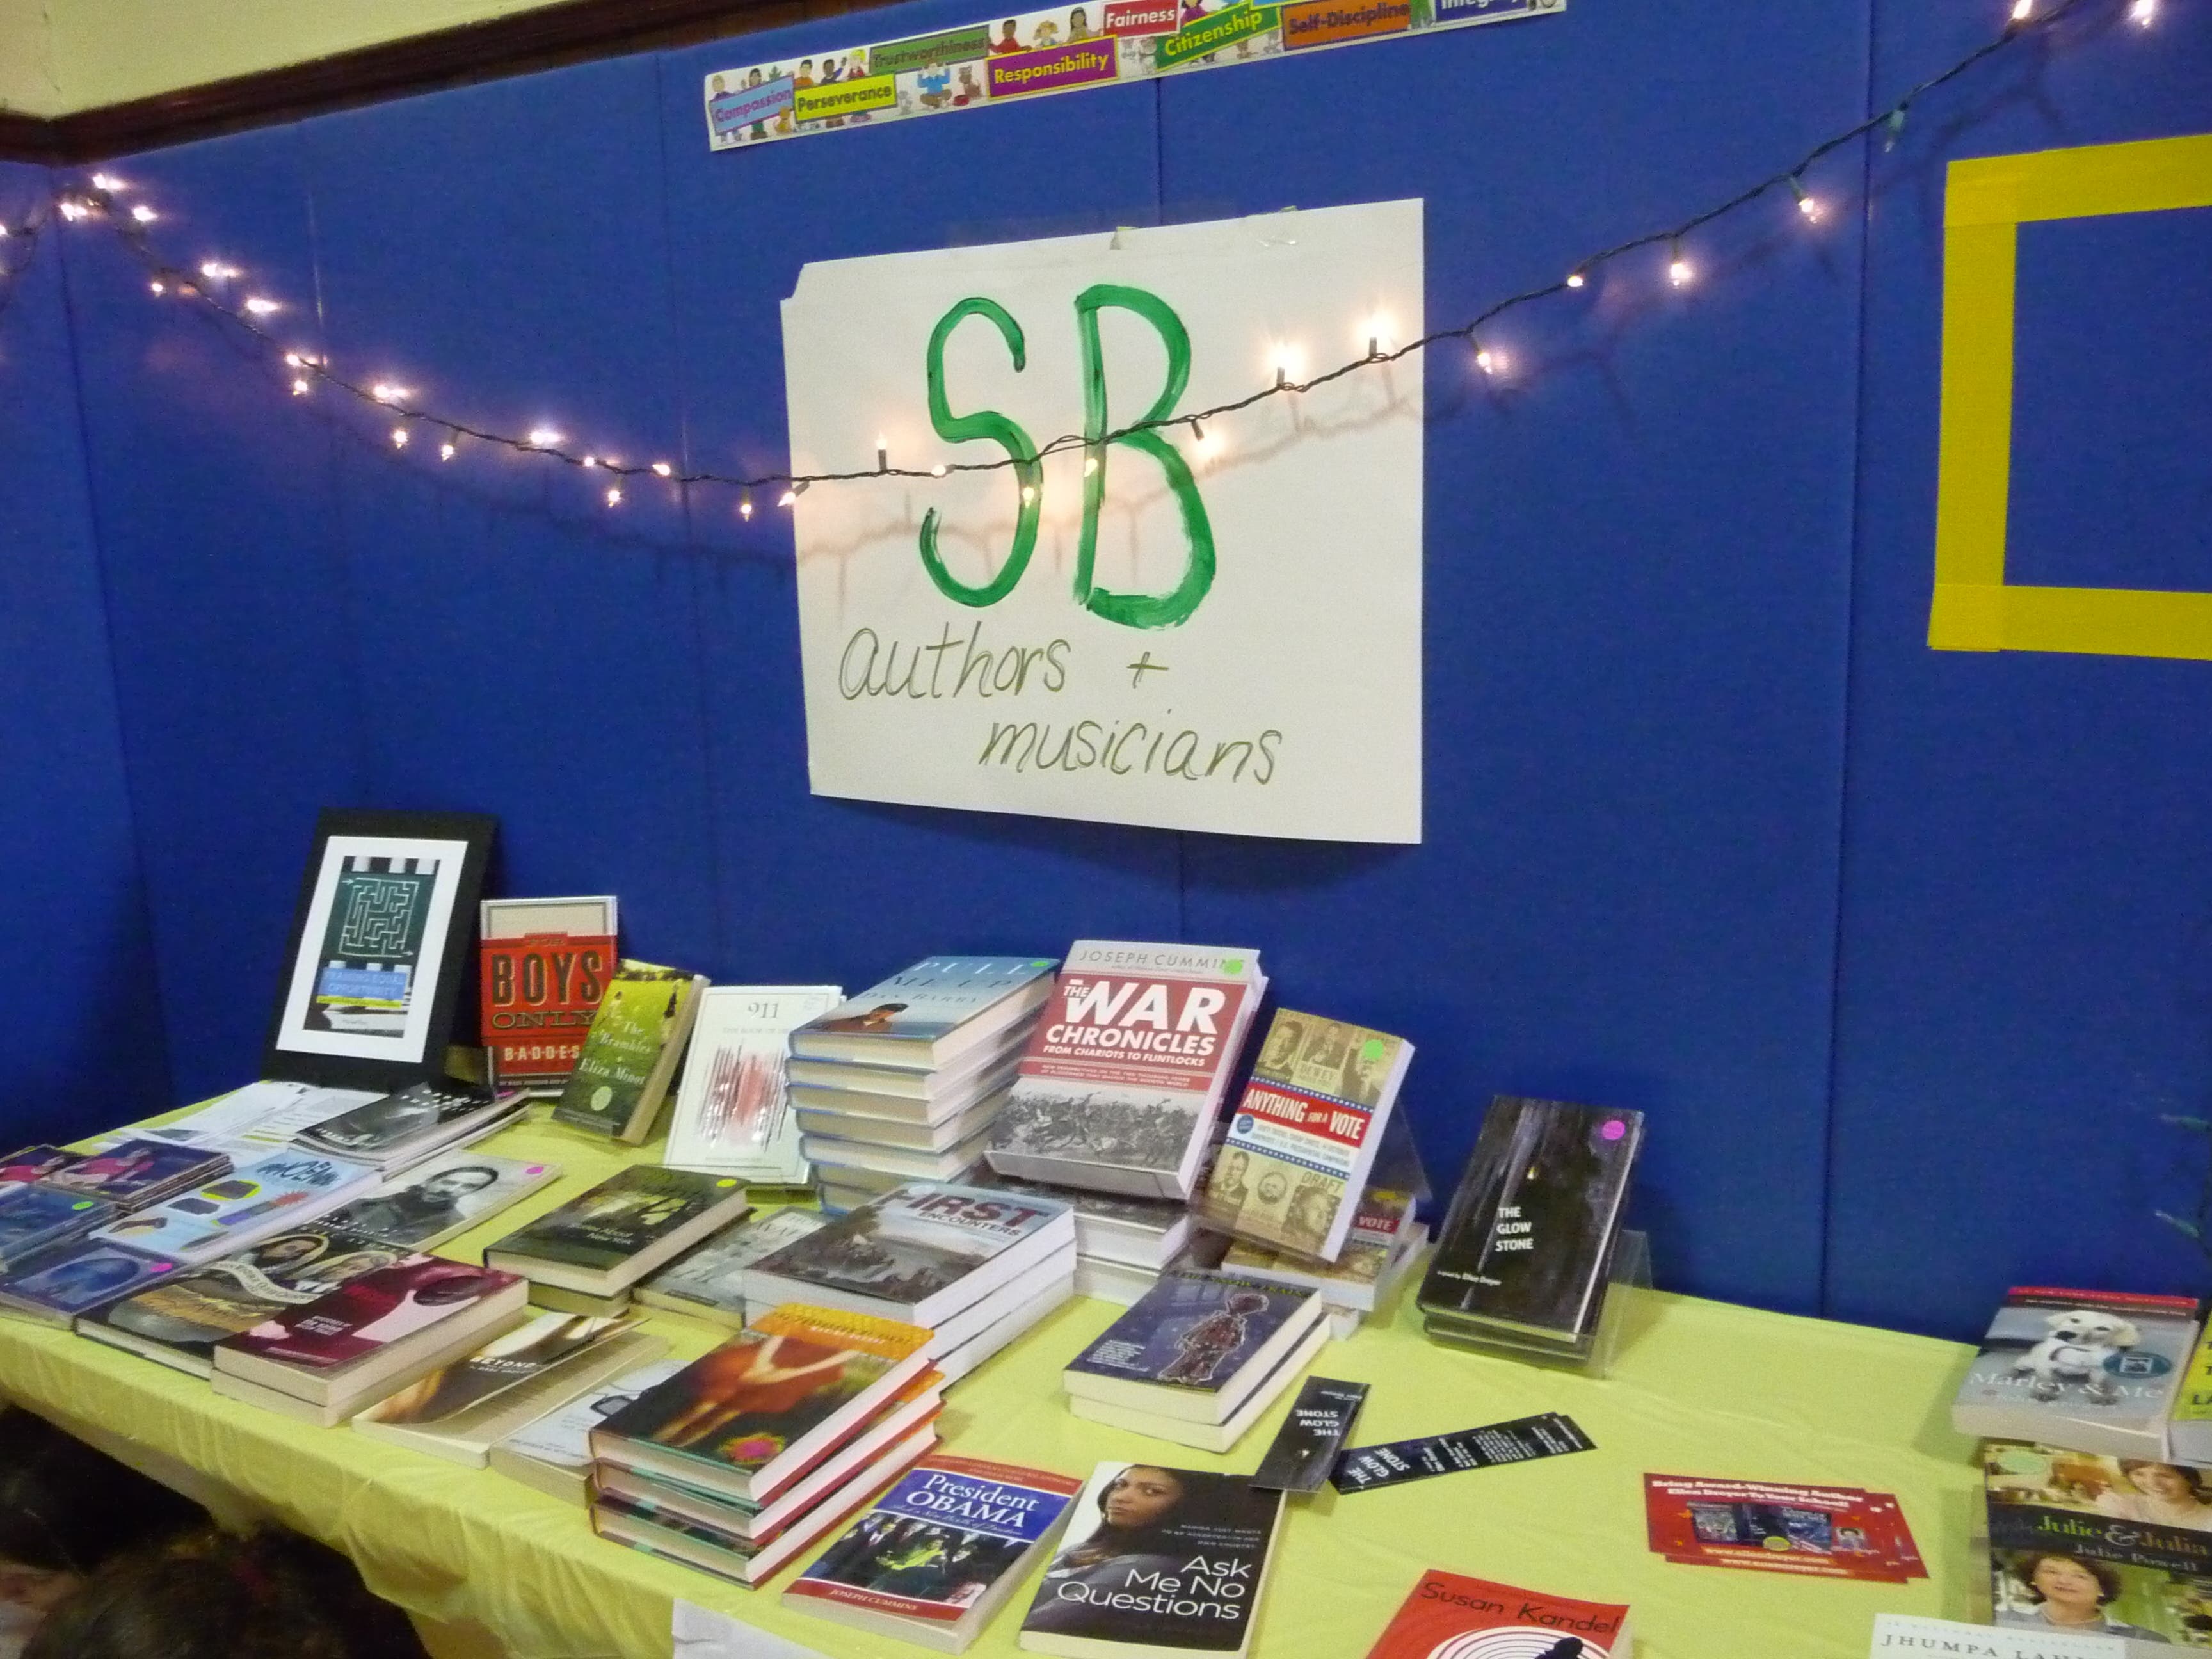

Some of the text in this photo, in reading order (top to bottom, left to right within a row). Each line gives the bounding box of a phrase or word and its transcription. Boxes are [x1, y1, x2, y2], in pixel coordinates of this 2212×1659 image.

[1106, 9, 1176, 29] Fairness
[1288, 2, 1409, 35] Self-Discipline
[1164, 10, 1262, 57] Citizenship
[994, 52, 1109, 84] Responsibility
[715, 88, 792, 122] Compassion
[797, 84, 892, 112] Perseverance
[919, 284, 1216, 630] SB
[978, 709, 1283, 785] musicians
[1078, 950, 1148, 964] JOSEPH
[491, 950, 603, 1007] BOYS
[1063, 985, 1090, 998] THE
[748, 1002, 779, 1019] 911
[1065, 979, 1226, 1034] WAR
[492, 1009, 598, 1029] ONLY
[1045, 1024, 1217, 1057] CHRONICLES
[579, 1057, 611, 1077] Eliza
[1043, 1045, 1205, 1068] FROM CHARIOTS TO FLINTLOCKS
[1243, 1088, 1309, 1123] ANYTHING
[1329, 1110, 1366, 1141] VOTE
[1301, 1171, 1344, 1191] DRAFT
[918, 1211, 1022, 1236] ENCOUNTERS
[1359, 1216, 1395, 1231] VOTE
[1497, 1206, 1522, 1218] THE
[1496, 1222, 1532, 1235] GLOW
[1495, 1238, 1534, 1251] STONE
[469, 1356, 537, 1368] BEYOND
[1966, 1372, 2074, 1397] Marley
[2115, 1384, 2163, 1399] Me
[1296, 1409, 1339, 1418] STONE
[1359, 1455, 1390, 1478] GLOW
[1374, 1447, 1411, 1471] STONE
[1347, 1468, 1372, 1485] THE
[922, 1473, 1040, 1511] President
[906, 1490, 1025, 1528] OBAMA
[2037, 1515, 2092, 1536] Julie
[2074, 1544, 2124, 1560] Julie
[1181, 1555, 1253, 1578] Ask
[1125, 1569, 1246, 1599] Me No
[829, 1589, 918, 1611] JOSEPH CUMMINS
[1057, 1581, 1242, 1620] Questions
[1420, 1581, 1621, 1634] Susan Kandel
[1881, 1633, 1999, 1658] JHUMPA
